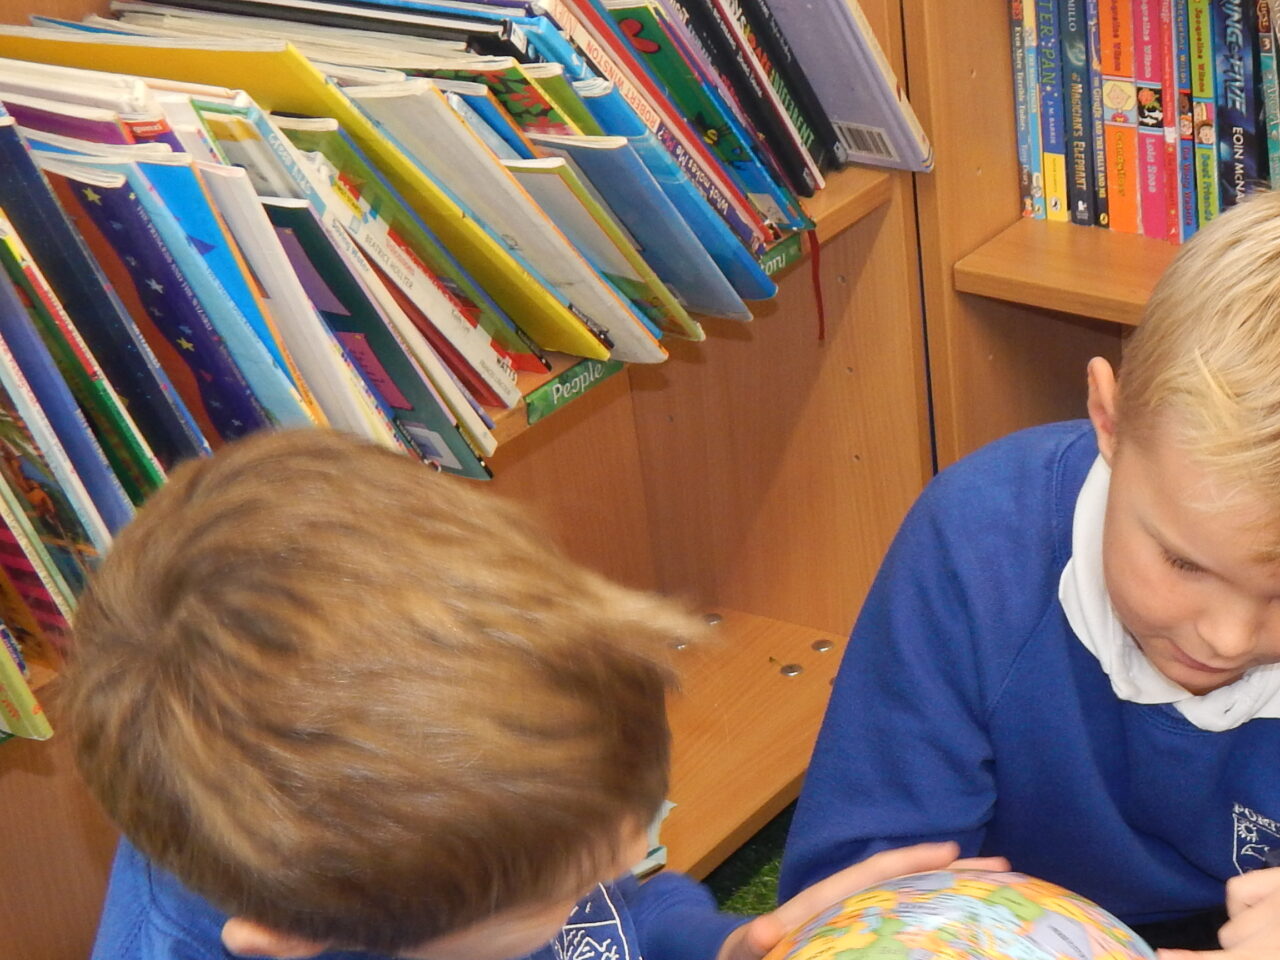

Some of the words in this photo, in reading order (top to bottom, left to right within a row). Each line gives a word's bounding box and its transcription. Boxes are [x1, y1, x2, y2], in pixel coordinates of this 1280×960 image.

[1013, 24, 1023, 47] Even
[1174, 0, 1186, 50] Jacqueline
[1190, 7, 1204, 59] Jacqueline
[581, 38, 626, 90] WINSTON
[1015, 47, 1025, 70] More
[1039, 45, 1057, 86] PAN
[1111, 41, 1122, 71] Wilson
[1141, 44, 1154, 78] Wilson
[1178, 53, 1187, 84] Wilson
[1016, 70, 1027, 102] Terrible
[1196, 63, 1206, 93] Wilson
[1223, 57, 1246, 117] FIVE
[622, 86, 658, 127] ROBERT
[771, 71, 814, 147] DIFFERENT
[1018, 103, 1028, 131] Tudors
[1069, 81, 1086, 136] MAGICIAN'S
[1091, 87, 1104, 118] Giraffe
[1094, 119, 1103, 134] AND
[1095, 135, 1104, 149] THE
[670, 144, 690, 164] Me
[1144, 137, 1155, 163] Lola
[1182, 145, 1190, 159] The
[1230, 126, 1243, 159] EOIN
[683, 158, 712, 190] makes
[1072, 139, 1089, 191] ELEPHANT
[1096, 149, 1105, 171] PELLY
[1180, 162, 1191, 188] Worry
[1200, 152, 1211, 178] Best
[1097, 171, 1106, 187] AND
[1145, 165, 1158, 193] Rose
[704, 185, 732, 215] What
[1182, 190, 1194, 226] Website
[1200, 180, 1214, 221] Friends
[551, 361, 606, 404] People
